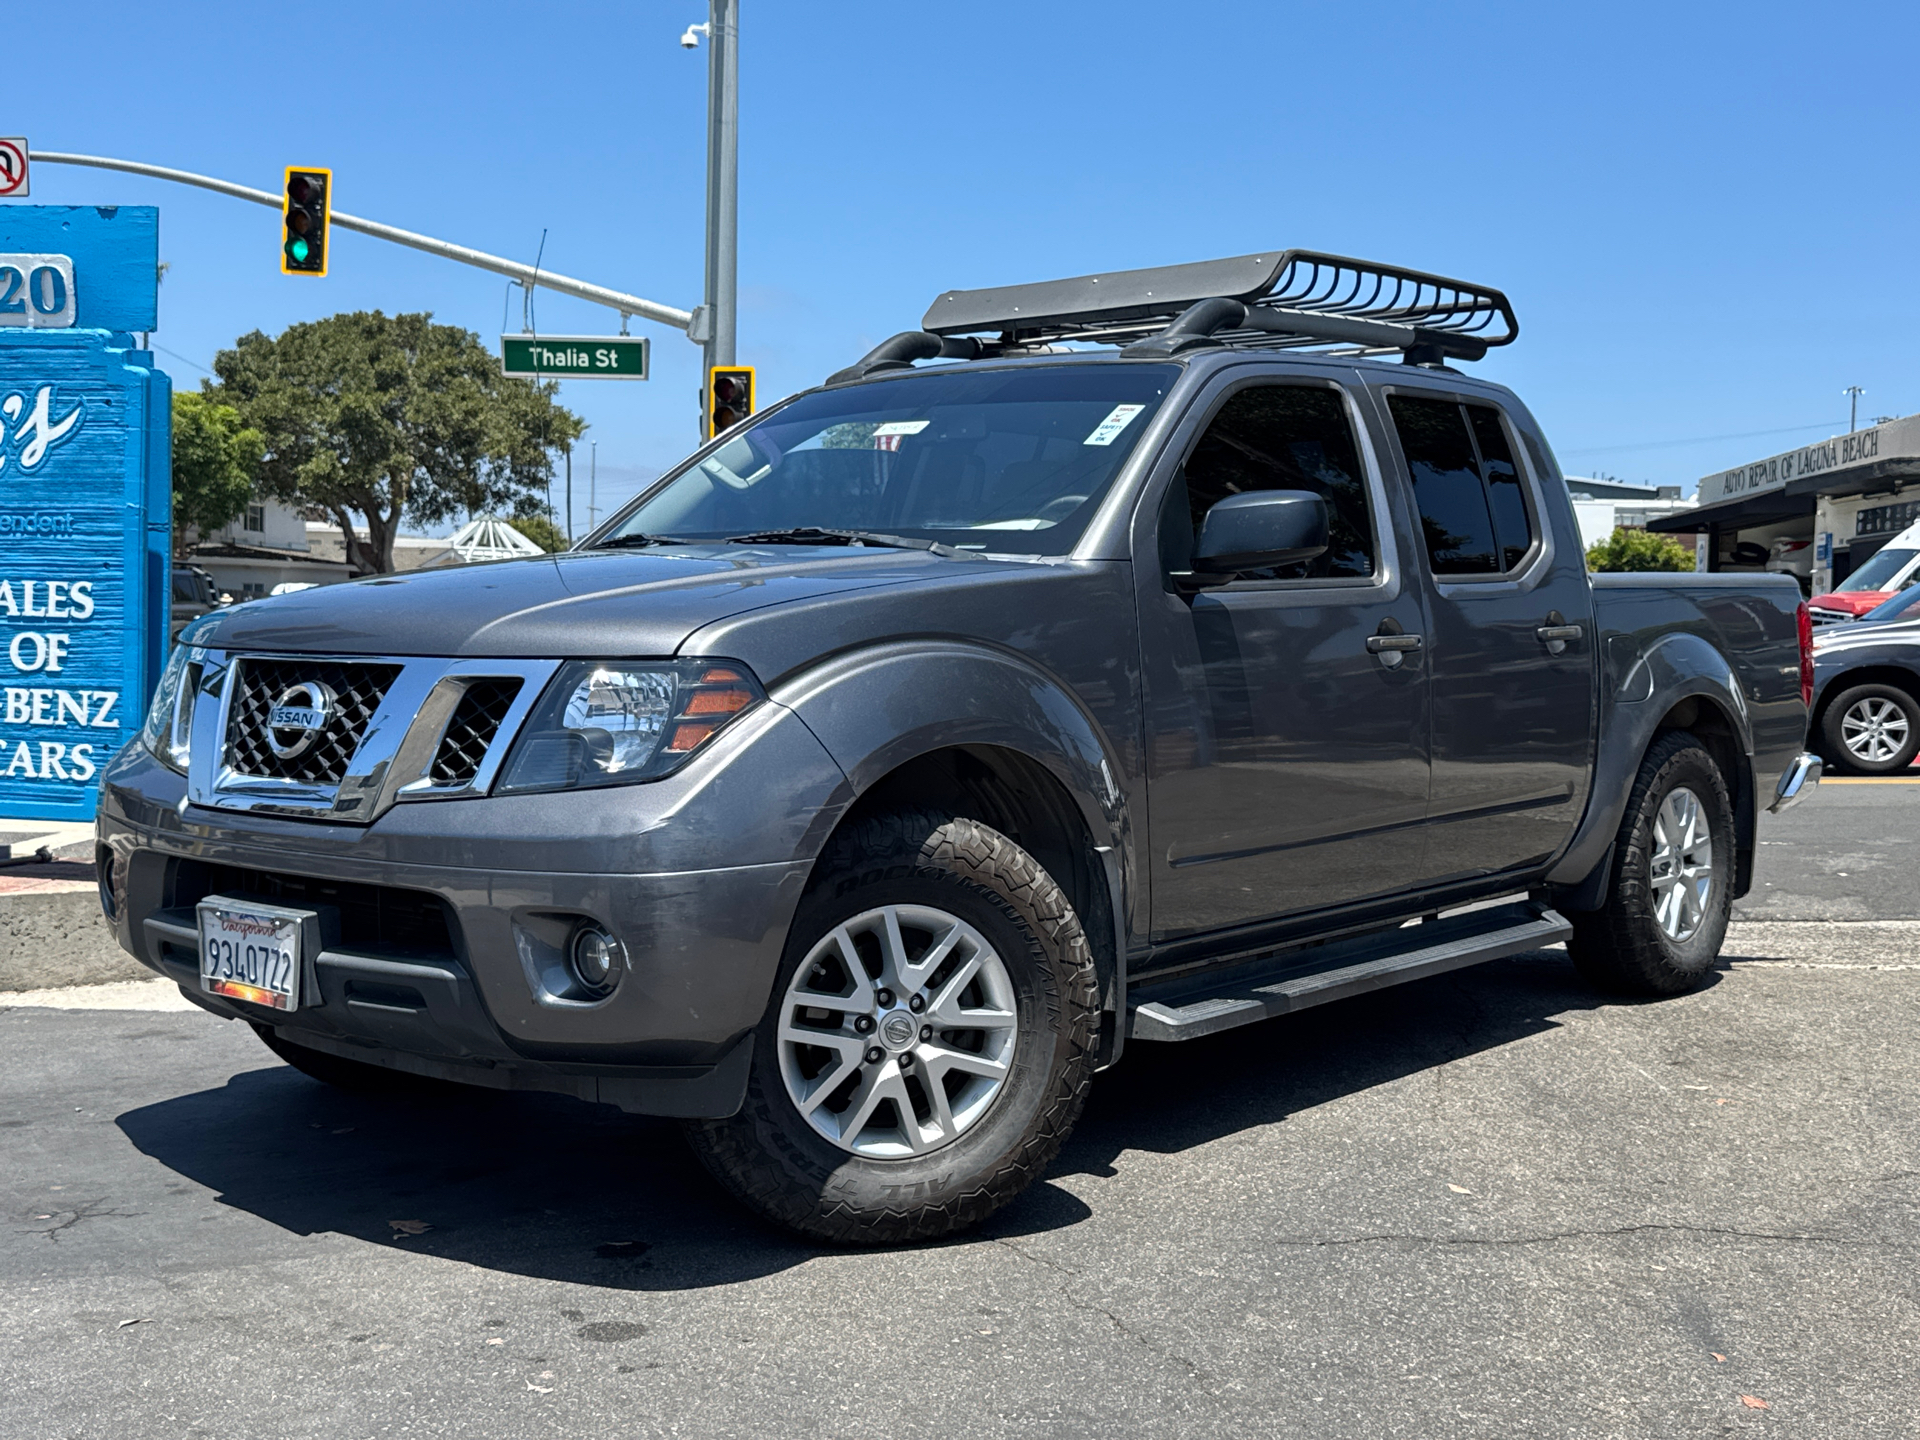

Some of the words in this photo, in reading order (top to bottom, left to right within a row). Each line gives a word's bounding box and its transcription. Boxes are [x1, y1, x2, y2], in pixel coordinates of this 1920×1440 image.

[0, 266, 66, 314] 20
[529, 347, 589, 367] Thalia
[595, 349, 618, 368] St
[1723, 470, 1744, 495] AUTO
[1749, 460, 1777, 488] REPAIR
[1781, 455, 1793, 480] OF
[1798, 443, 1837, 475] LAGUNA
[1842, 430, 1879, 464] BEACH
[0, 579, 94, 620] ALES
[9, 631, 70, 672] OF
